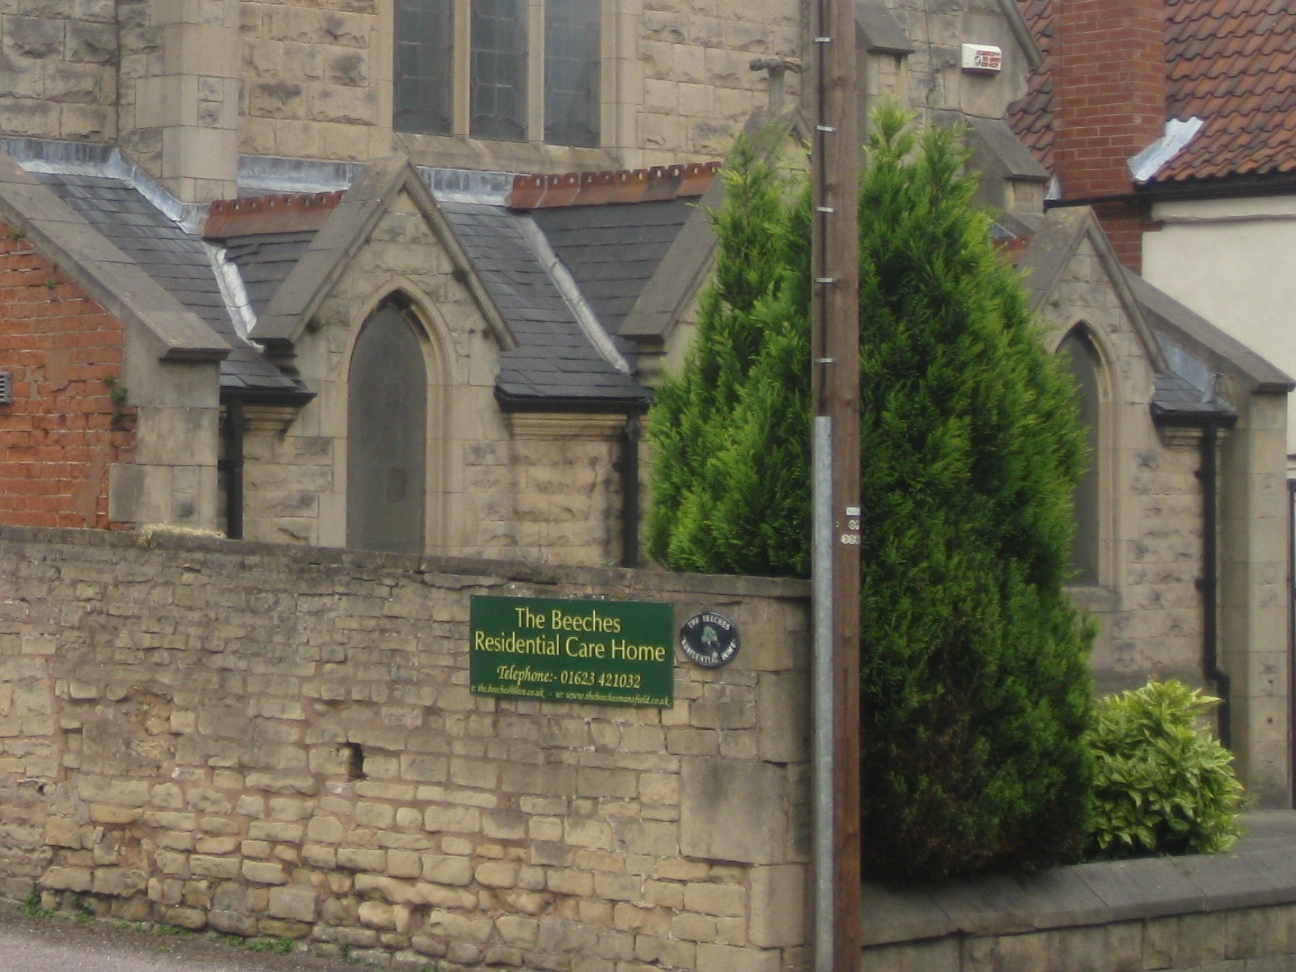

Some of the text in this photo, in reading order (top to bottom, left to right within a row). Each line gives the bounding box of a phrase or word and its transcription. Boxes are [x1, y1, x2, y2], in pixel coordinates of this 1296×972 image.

[515, 607, 621, 633] The Beeches
[475, 630, 666, 662] Residential Care Home
[560, 670, 595, 685] 01623
[598, 672, 641, 689] 421032
